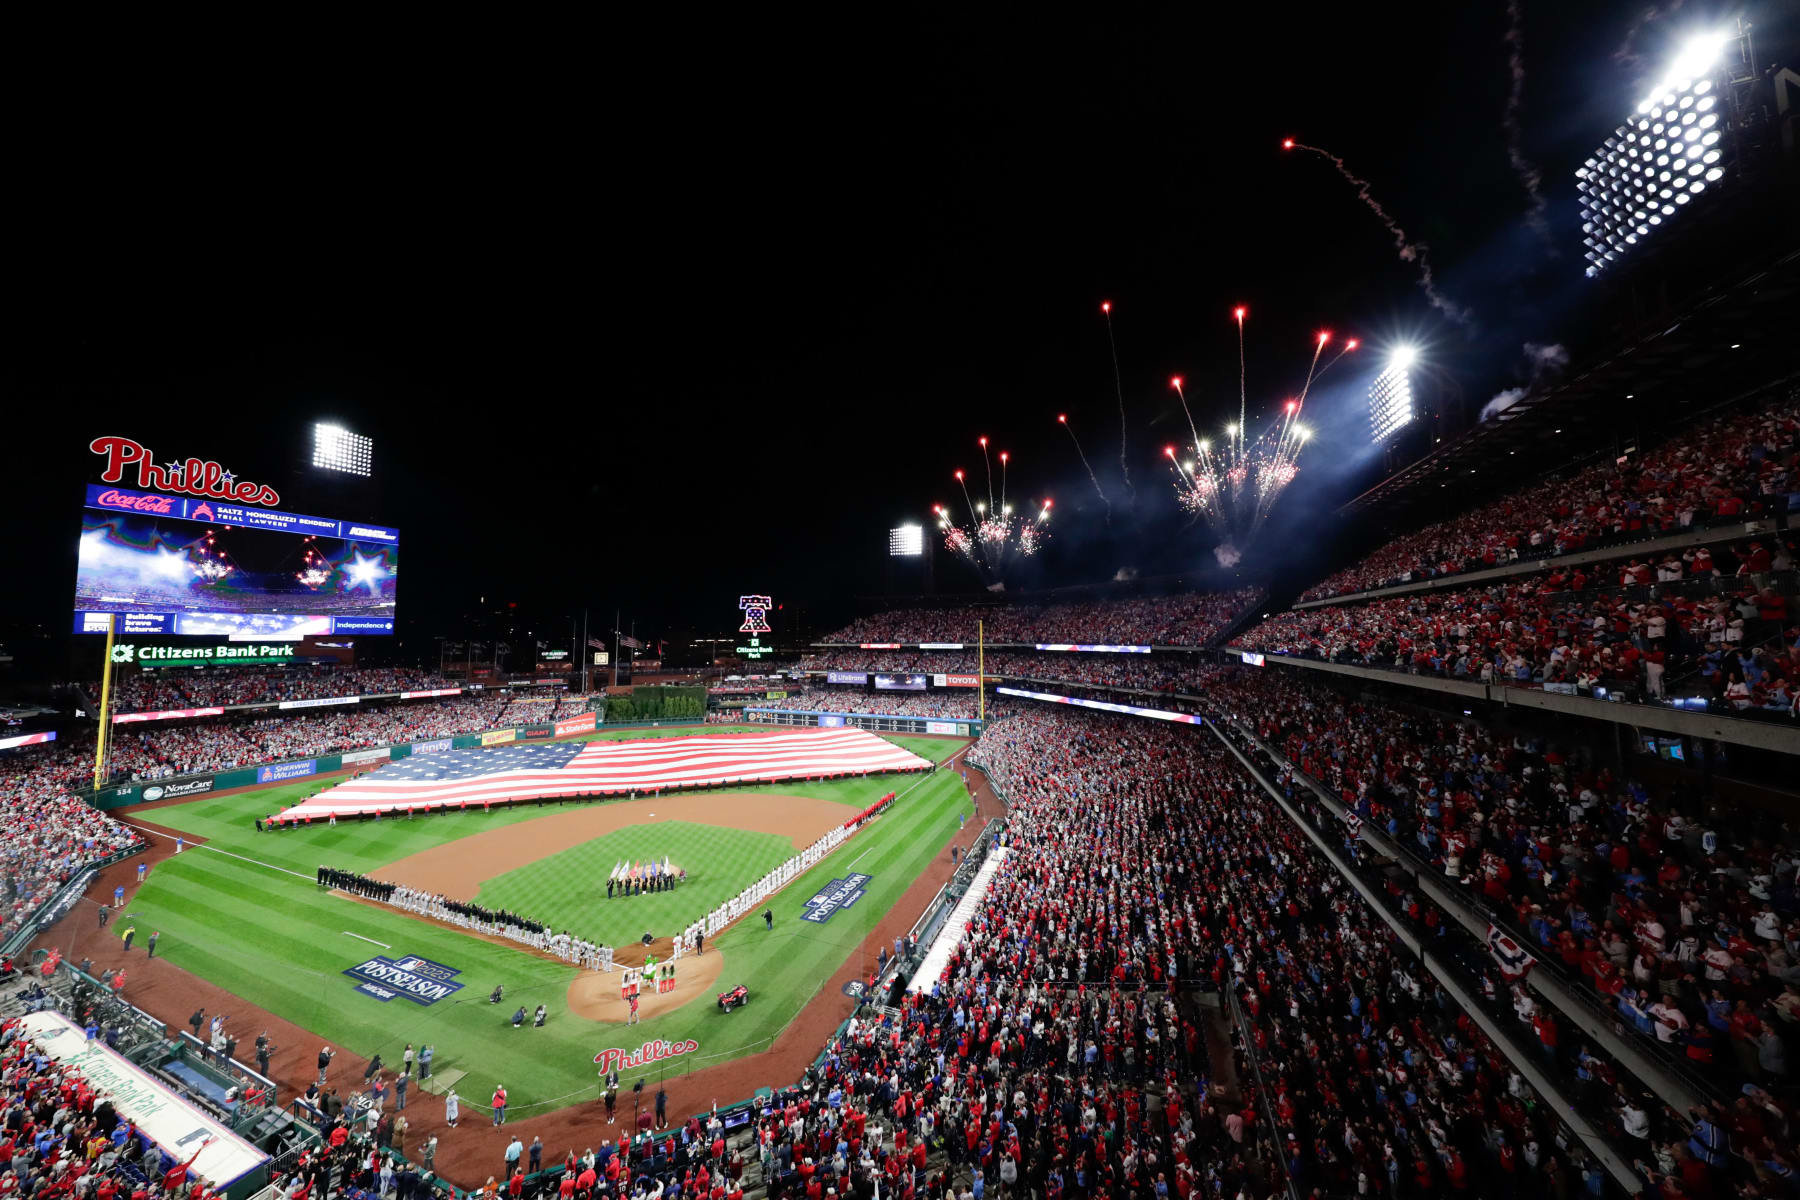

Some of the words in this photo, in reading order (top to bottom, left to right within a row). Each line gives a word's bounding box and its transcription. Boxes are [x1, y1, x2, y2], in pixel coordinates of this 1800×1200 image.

[89, 436, 280, 506] Phillies
[97, 490, 176, 513] Coca-Cola
[217, 507, 243, 516] SALTZ
[246, 511, 297, 523] MONGELUZZI
[299, 519, 336, 529] BENDESKY
[217, 514, 243, 522] TRIAL
[249, 518, 288, 528] LAWYERS
[125, 613, 165, 622] Building
[138, 646, 213, 659] Citizens
[216, 645, 257, 658] Bank
[260, 644, 294, 656] Park
[526, 729, 551, 737] GIANT
[164, 780, 213, 794] NovaCare
[808, 874, 867, 921] POSTSEASON
[355, 960, 453, 1000] POSTSEASON
[415, 965, 452, 980] 2023
[593, 1039, 699, 1076] Phillies
[130, 1094, 168, 1118] Park
